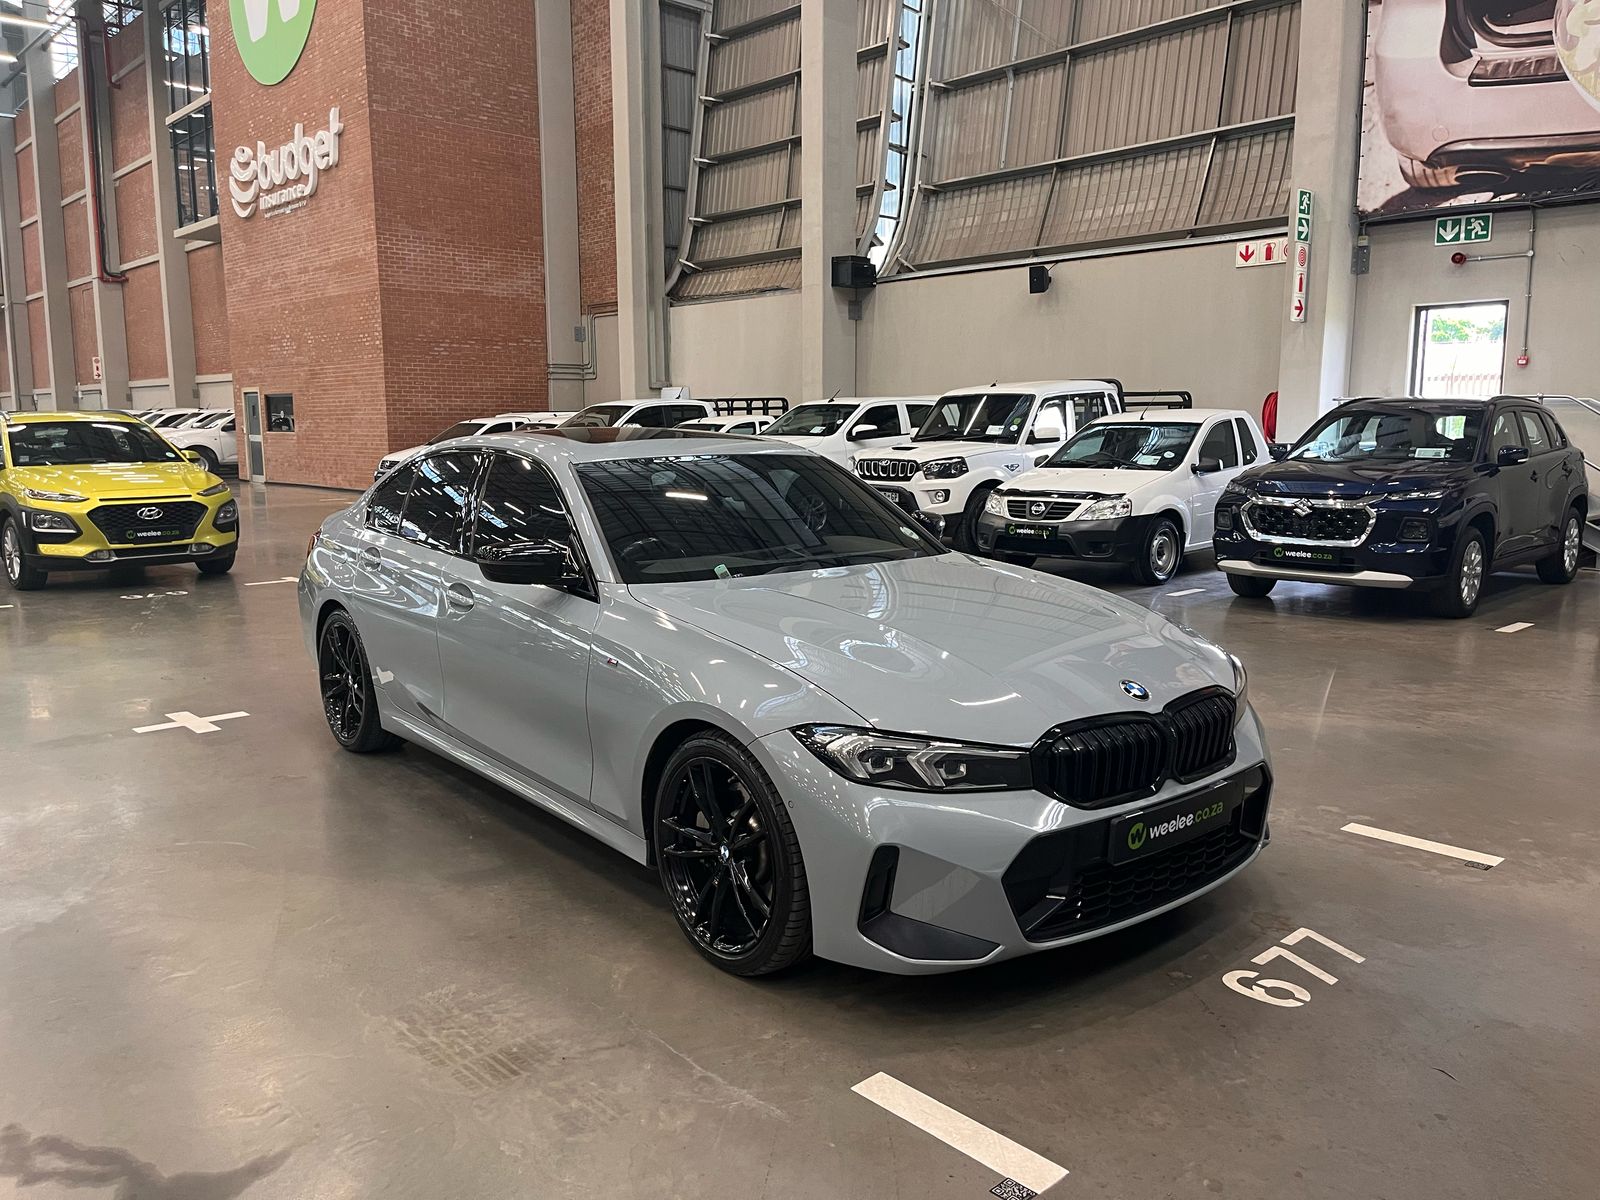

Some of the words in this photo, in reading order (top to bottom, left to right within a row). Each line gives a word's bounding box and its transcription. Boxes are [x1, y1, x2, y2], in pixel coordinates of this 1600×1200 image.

[257, 106, 344, 197] budget
[1285, 551, 1332, 559] weelee.co.za
[1150, 801, 1224, 839] weelee.co.za
[1222, 927, 1366, 1008] 677
